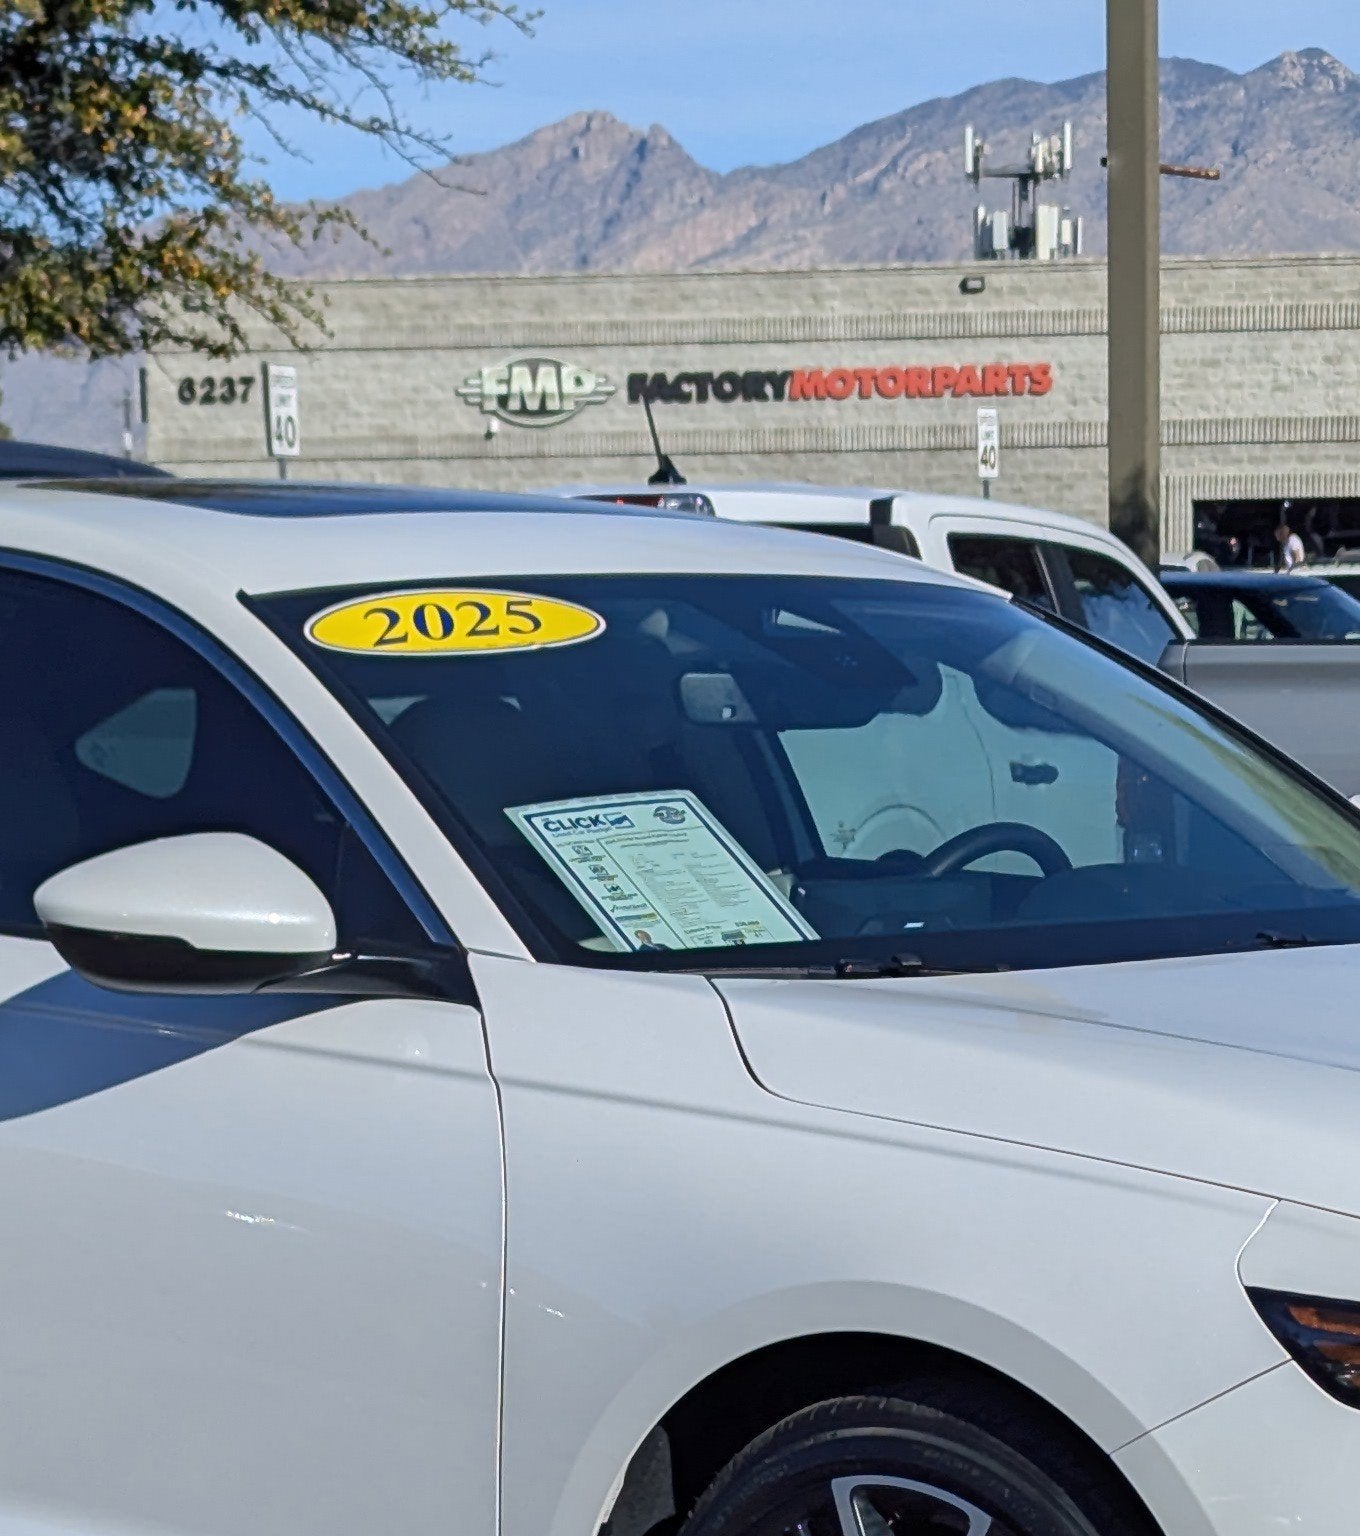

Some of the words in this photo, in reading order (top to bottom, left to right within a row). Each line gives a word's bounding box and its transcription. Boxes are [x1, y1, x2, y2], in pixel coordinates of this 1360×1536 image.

[178, 376, 255, 405] 6237
[479, 364, 596, 412] FMP
[275, 414, 296, 448] 40
[980, 444, 996, 470] 40
[363, 600, 542, 648] 2025
[542, 813, 607, 833] CLICK
